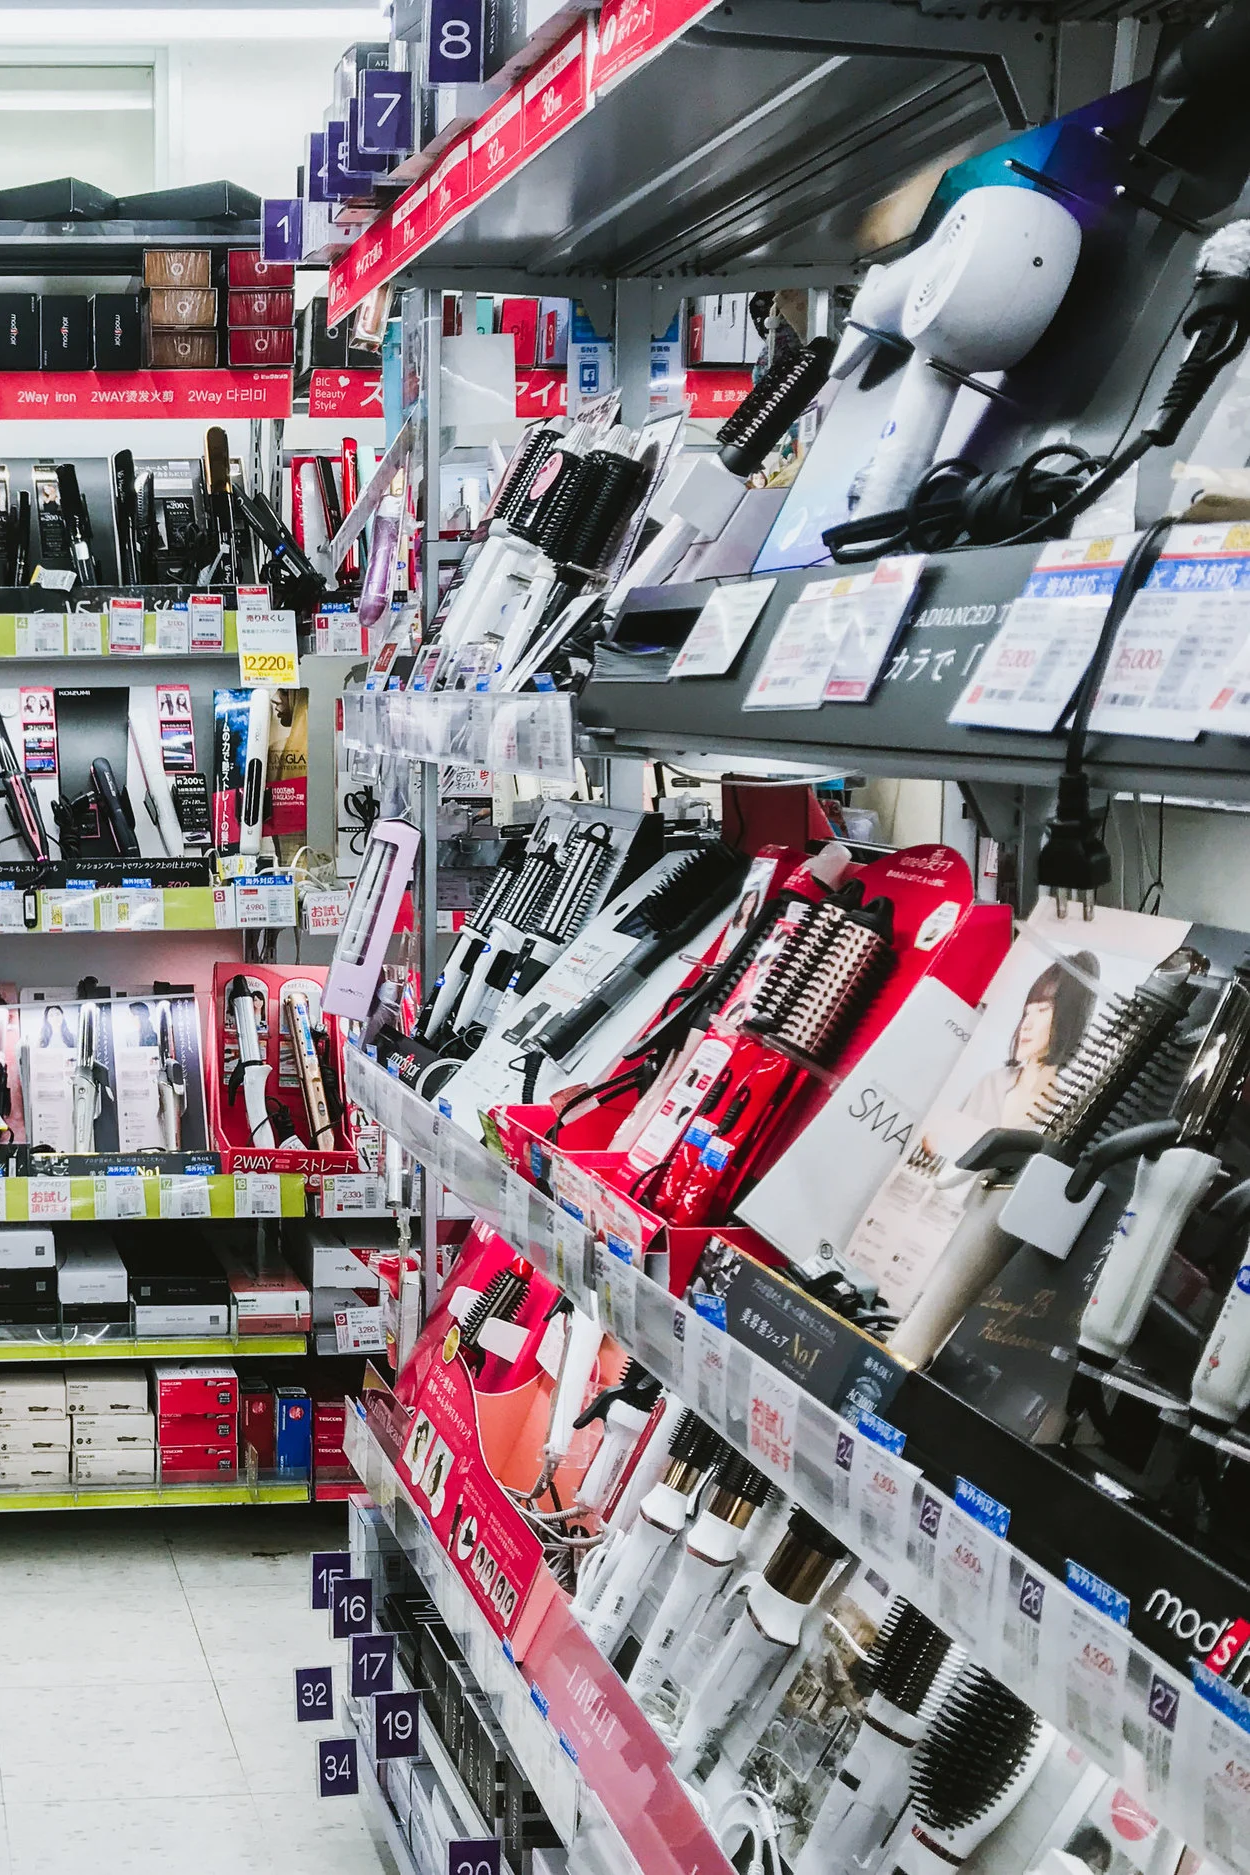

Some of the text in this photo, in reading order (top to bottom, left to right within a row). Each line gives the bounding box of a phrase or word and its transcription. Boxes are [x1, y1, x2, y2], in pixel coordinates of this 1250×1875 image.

[439, 19, 472, 60] 8
[373, 92, 402, 128] 7
[276, 215, 291, 243] 1
[315, 376, 332, 387] BIC
[17, 390, 50, 405] 2Way
[91, 389, 175, 403] 2WAY烫发火剪
[187, 387, 268, 405] 2Way 다리미
[314, 400, 338, 412] Style
[315, 389, 347, 402] Beauty
[1043, 574, 1100, 597] 海外対応
[245, 614, 285, 623] 売り尽くし
[914, 604, 997, 629] ADVANCED
[75, 861, 204, 871] クッションプレートでワンランク上の仕上がりへ
[245, 877, 275, 885] 海外対応
[310, 905, 347, 917] お試し
[848, 1088, 914, 1156] SMA
[233, 1154, 275, 1170] 2WAY
[295, 1157, 354, 1173] ストレート
[30, 1191, 68, 1203] お試し
[739, 1306, 790, 1349] 美容室シェア
[751, 1396, 791, 1447] お試し
[921, 1501, 942, 1533] 25
[338, 1595, 366, 1622] 16
[1020, 1581, 1044, 1618] 26
[358, 1652, 388, 1681] 17
[301, 1682, 328, 1708] 32
[1152, 1682, 1178, 1720] 27
[382, 1710, 413, 1741] 19
[324, 1755, 351, 1781] 34
